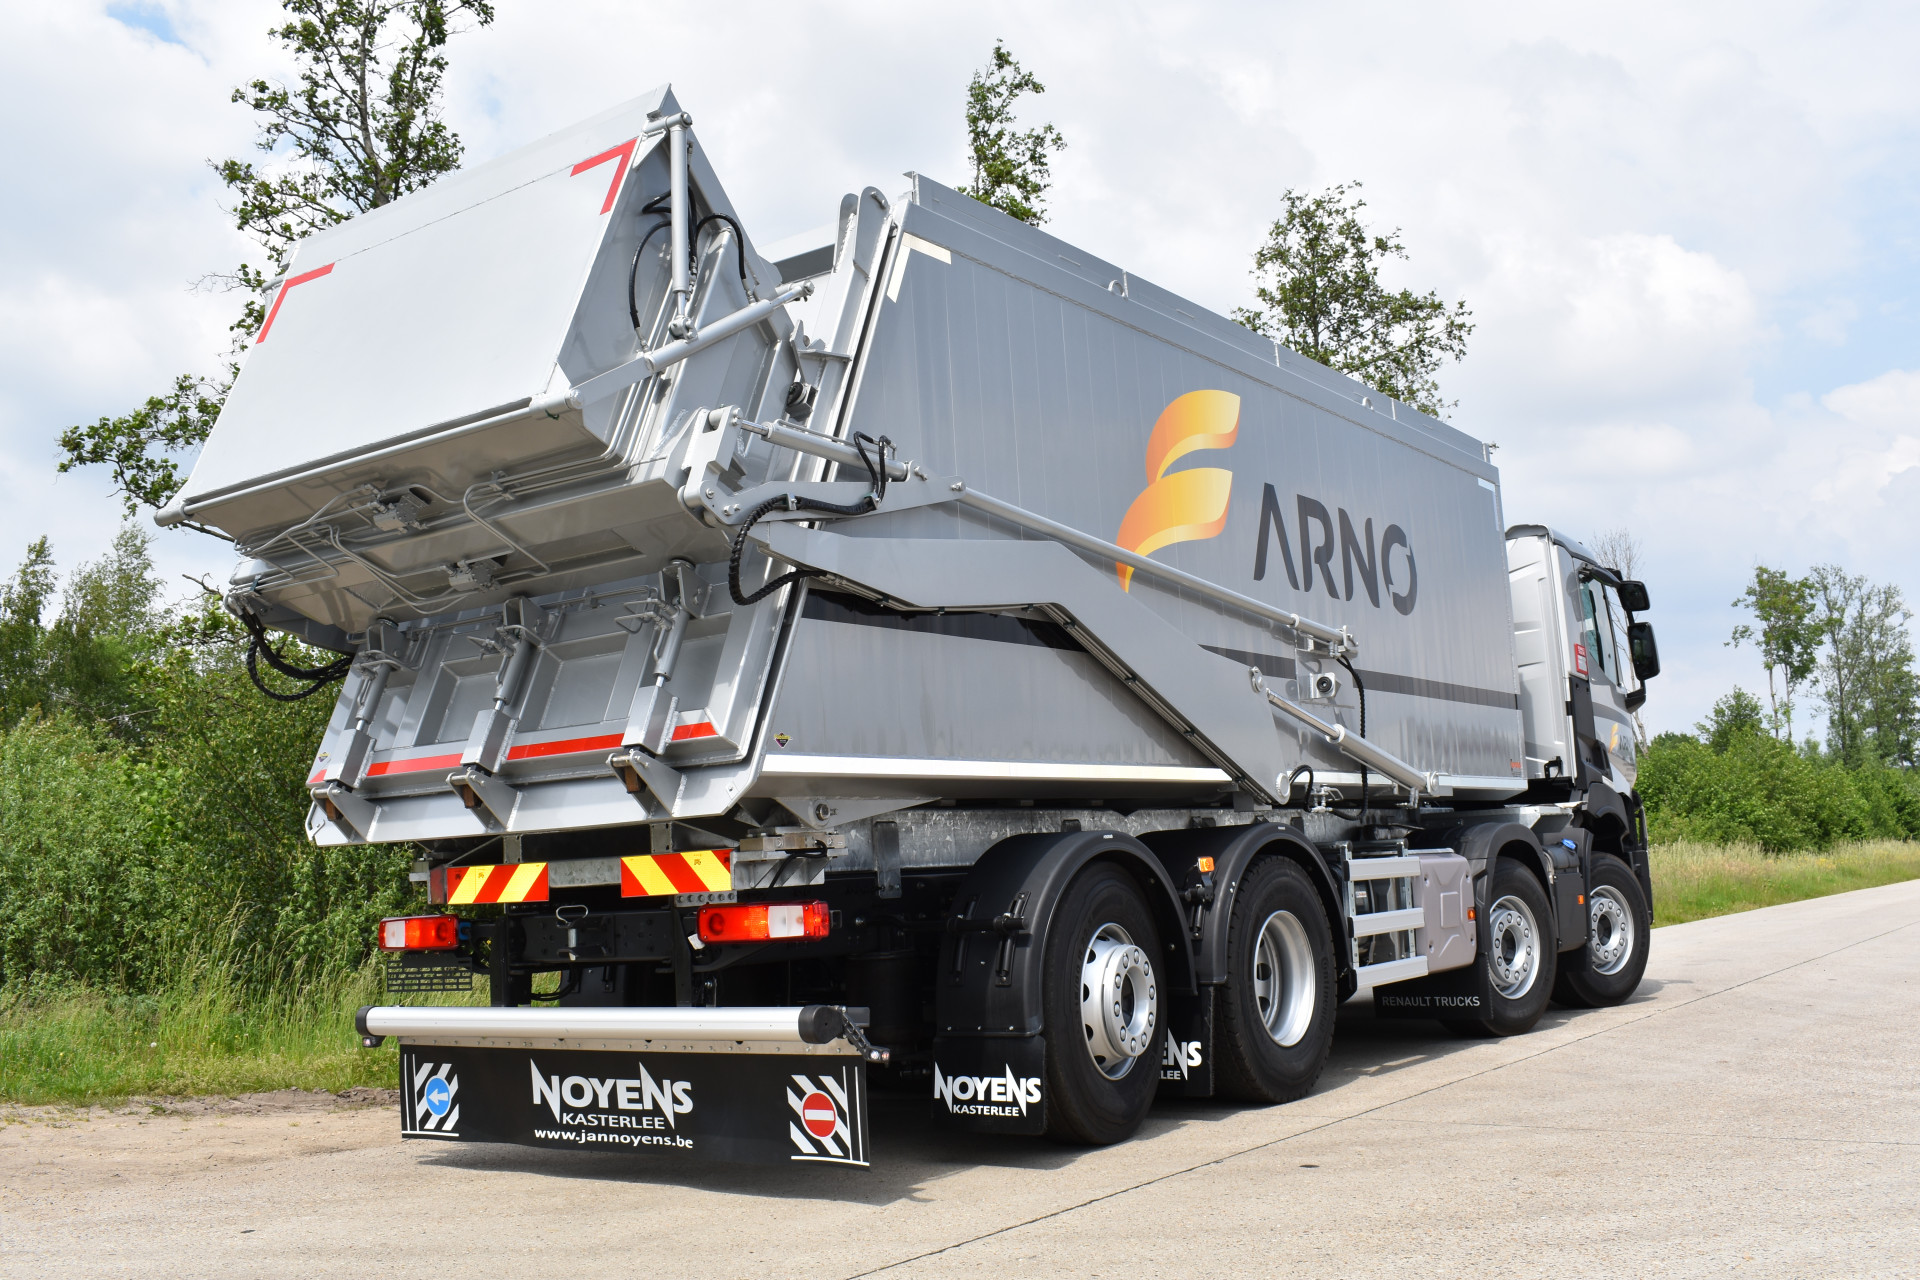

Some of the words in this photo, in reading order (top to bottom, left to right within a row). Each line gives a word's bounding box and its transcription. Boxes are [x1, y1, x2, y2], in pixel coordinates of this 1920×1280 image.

[1253, 482, 1418, 616] ARNO
[1382, 996, 1431, 1007] RENAULT
[1434, 996, 1481, 1007] TRUCKS
[530, 1058, 694, 1130] NOYENS
[934, 1061, 1042, 1118] NOYENS
[562, 1112, 665, 1129] KASTERLEE
[953, 1104, 1020, 1118] KASTERLEE
[534, 1129, 693, 1149] www.jannoyens.be
